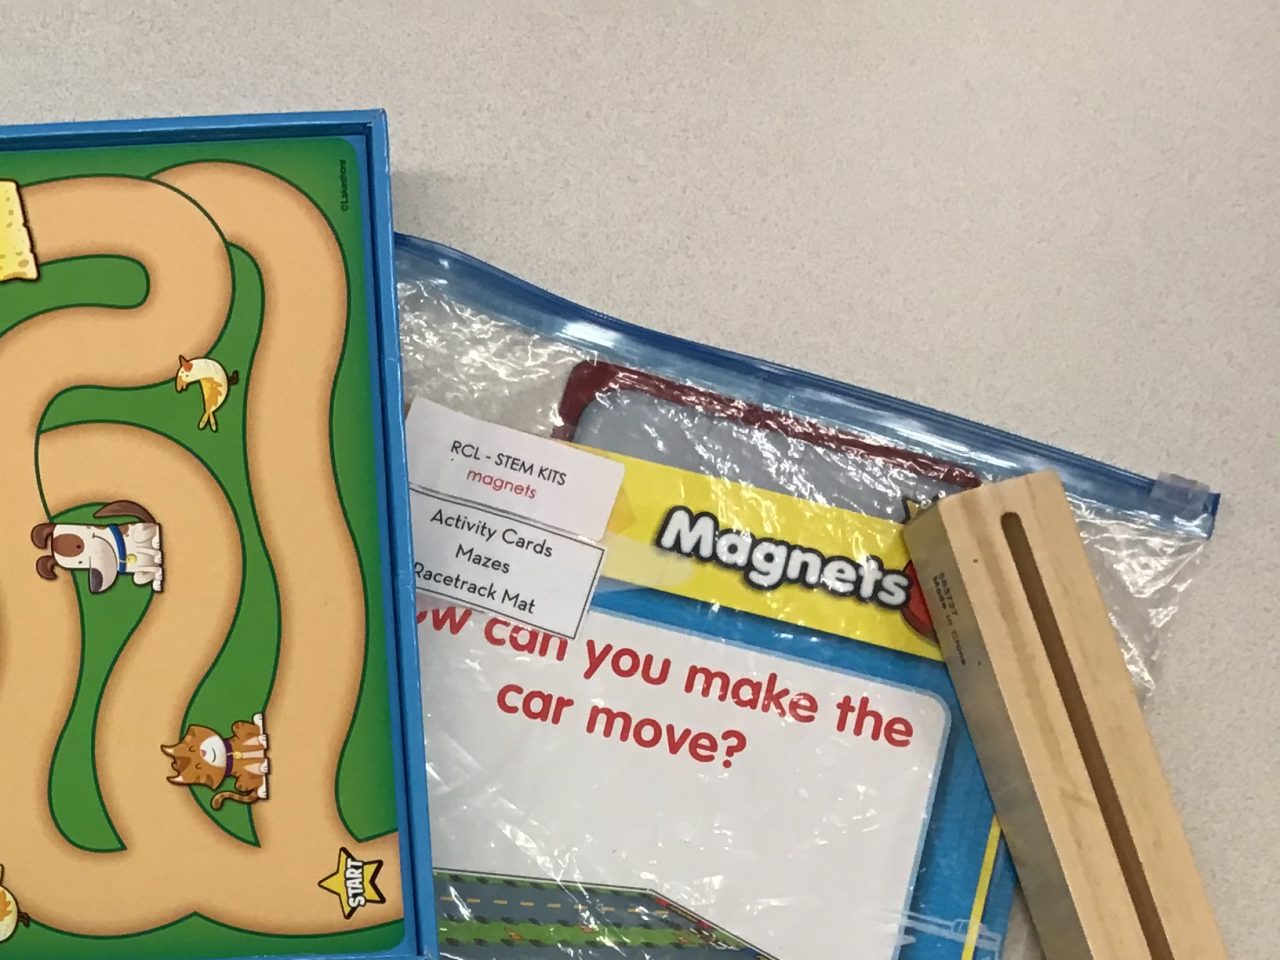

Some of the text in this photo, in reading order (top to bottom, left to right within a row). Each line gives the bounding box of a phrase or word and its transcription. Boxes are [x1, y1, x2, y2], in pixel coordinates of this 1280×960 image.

[450, 440, 482, 462] RCL
[494, 453, 535, 477] STEM
[537, 467, 568, 486] KITS
[467, 468, 537, 499] magnets
[430, 508, 554, 558] Activity Cards
[456, 544, 511, 574] Mazes
[660, 506, 911, 608] Magnets
[414, 562, 537, 615] Racetrack Mat
[932, 575, 947, 610] Made
[951, 630, 966, 666] China
[483, 612, 568, 661] can
[582, 639, 671, 686] you
[684, 660, 819, 724] make
[836, 695, 915, 748] the
[496, 678, 748, 769] car move?
[346, 857, 366, 908] START
